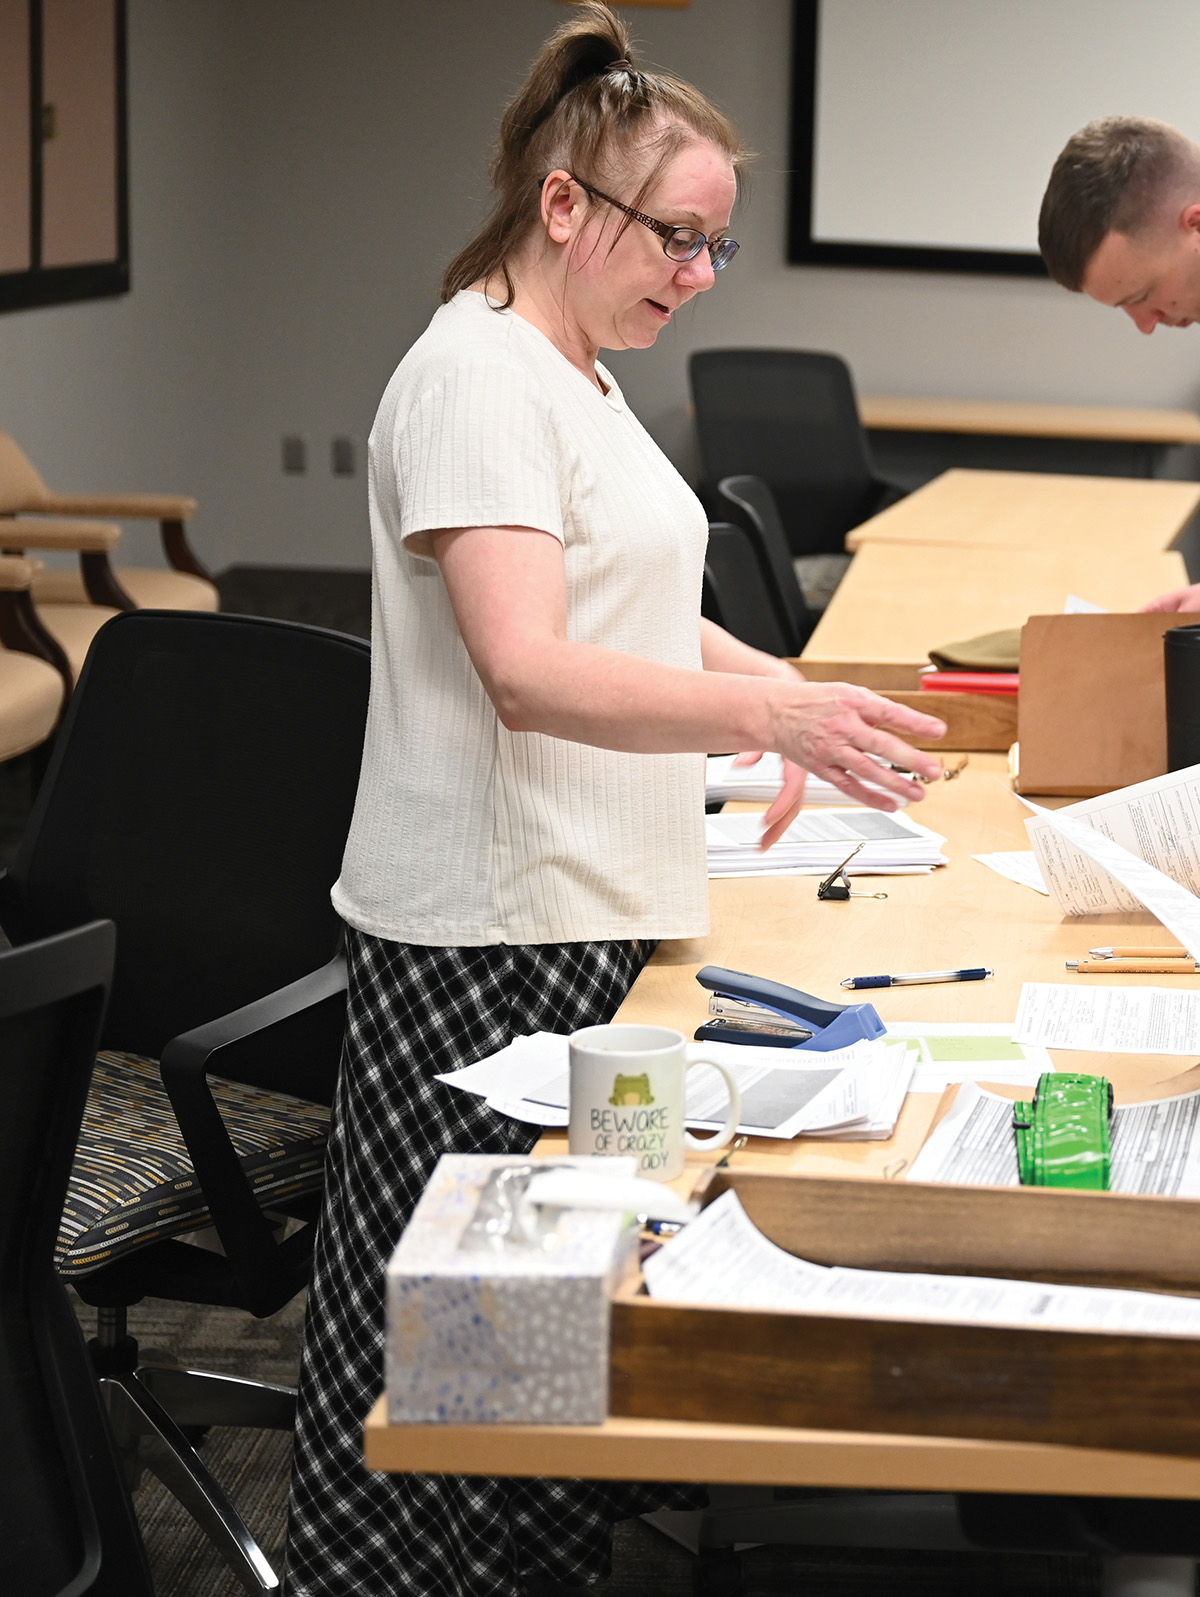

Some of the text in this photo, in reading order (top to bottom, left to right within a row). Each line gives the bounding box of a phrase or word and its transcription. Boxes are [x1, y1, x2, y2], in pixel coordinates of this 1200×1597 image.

[590, 1106, 669, 1133] BEWARE
[595, 1132, 666, 1152] OF CRAZY
[638, 1150, 669, 1171] ADY
